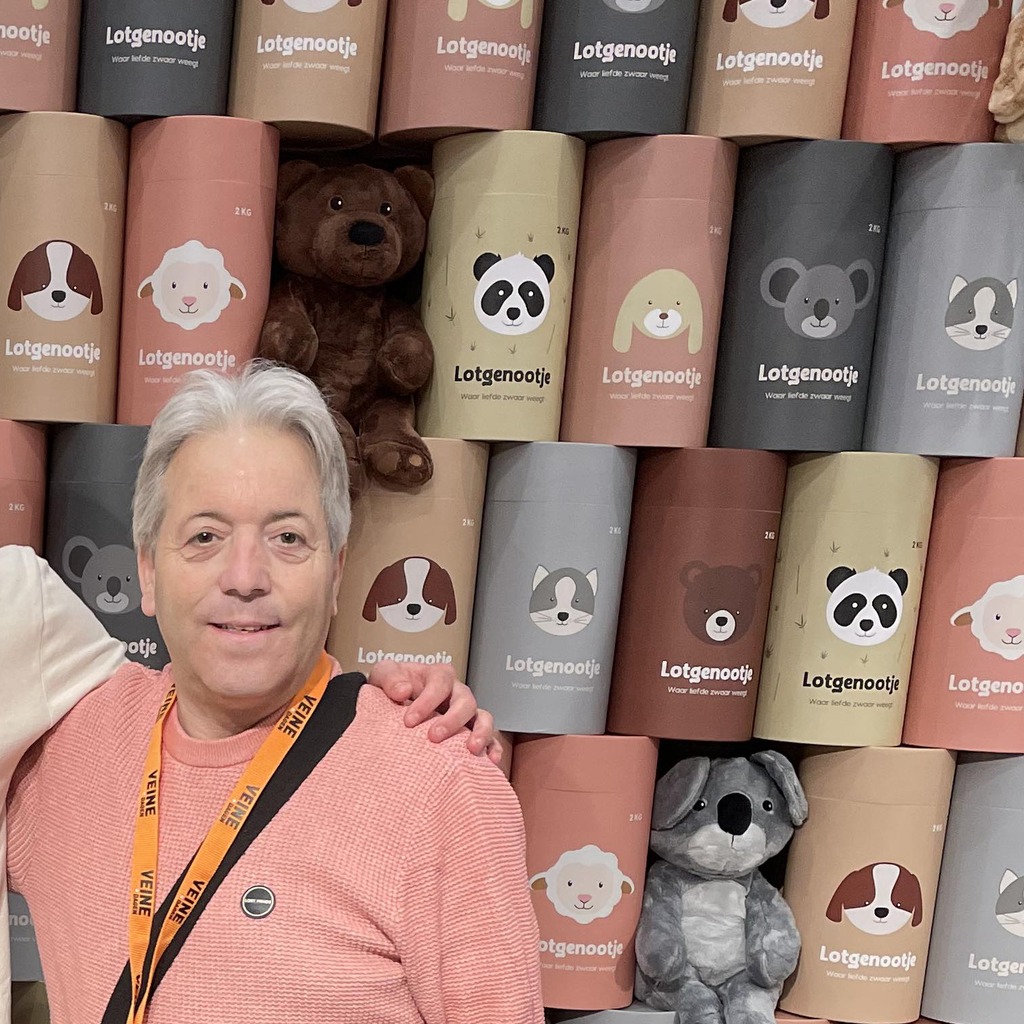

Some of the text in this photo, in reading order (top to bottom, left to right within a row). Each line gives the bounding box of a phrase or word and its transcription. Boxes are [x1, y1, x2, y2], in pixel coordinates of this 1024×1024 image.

[106, 26, 206, 53] Lotgenootje
[257, 34, 358, 60] Lotgenootje
[436, 36, 532, 66] Lotgenootje
[111, 55, 129, 63] Waar
[573, 40, 677, 66] Lotgenootje
[716, 49, 823, 73] Lotgenootje
[881, 59, 989, 84] Lotgenootje
[5, 339, 101, 364] Lotgenootje
[139, 349, 236, 372] Lotgenootje
[454, 365, 551, 389] Lotgenootje
[602, 366, 702, 389] Lotgenootje
[758, 364, 859, 388] Lotgenootje
[916, 373, 1016, 399] Lotgenootje
[506, 655, 601, 678] Lotgenootje
[660, 660, 753, 685] Lotgenootje
[802, 671, 900, 695] Lotgenootje
[809, 698, 829, 706] Waar
[282, 694, 317, 739] VEINE
[145, 769, 158, 817] VEINE
[225, 784, 260, 830] VEINE
[138, 870, 154, 917] VEINE
[172, 879, 205, 925] VEINE
[538, 939, 624, 958] otgenootje
[819, 945, 917, 972] Lotgenootje
